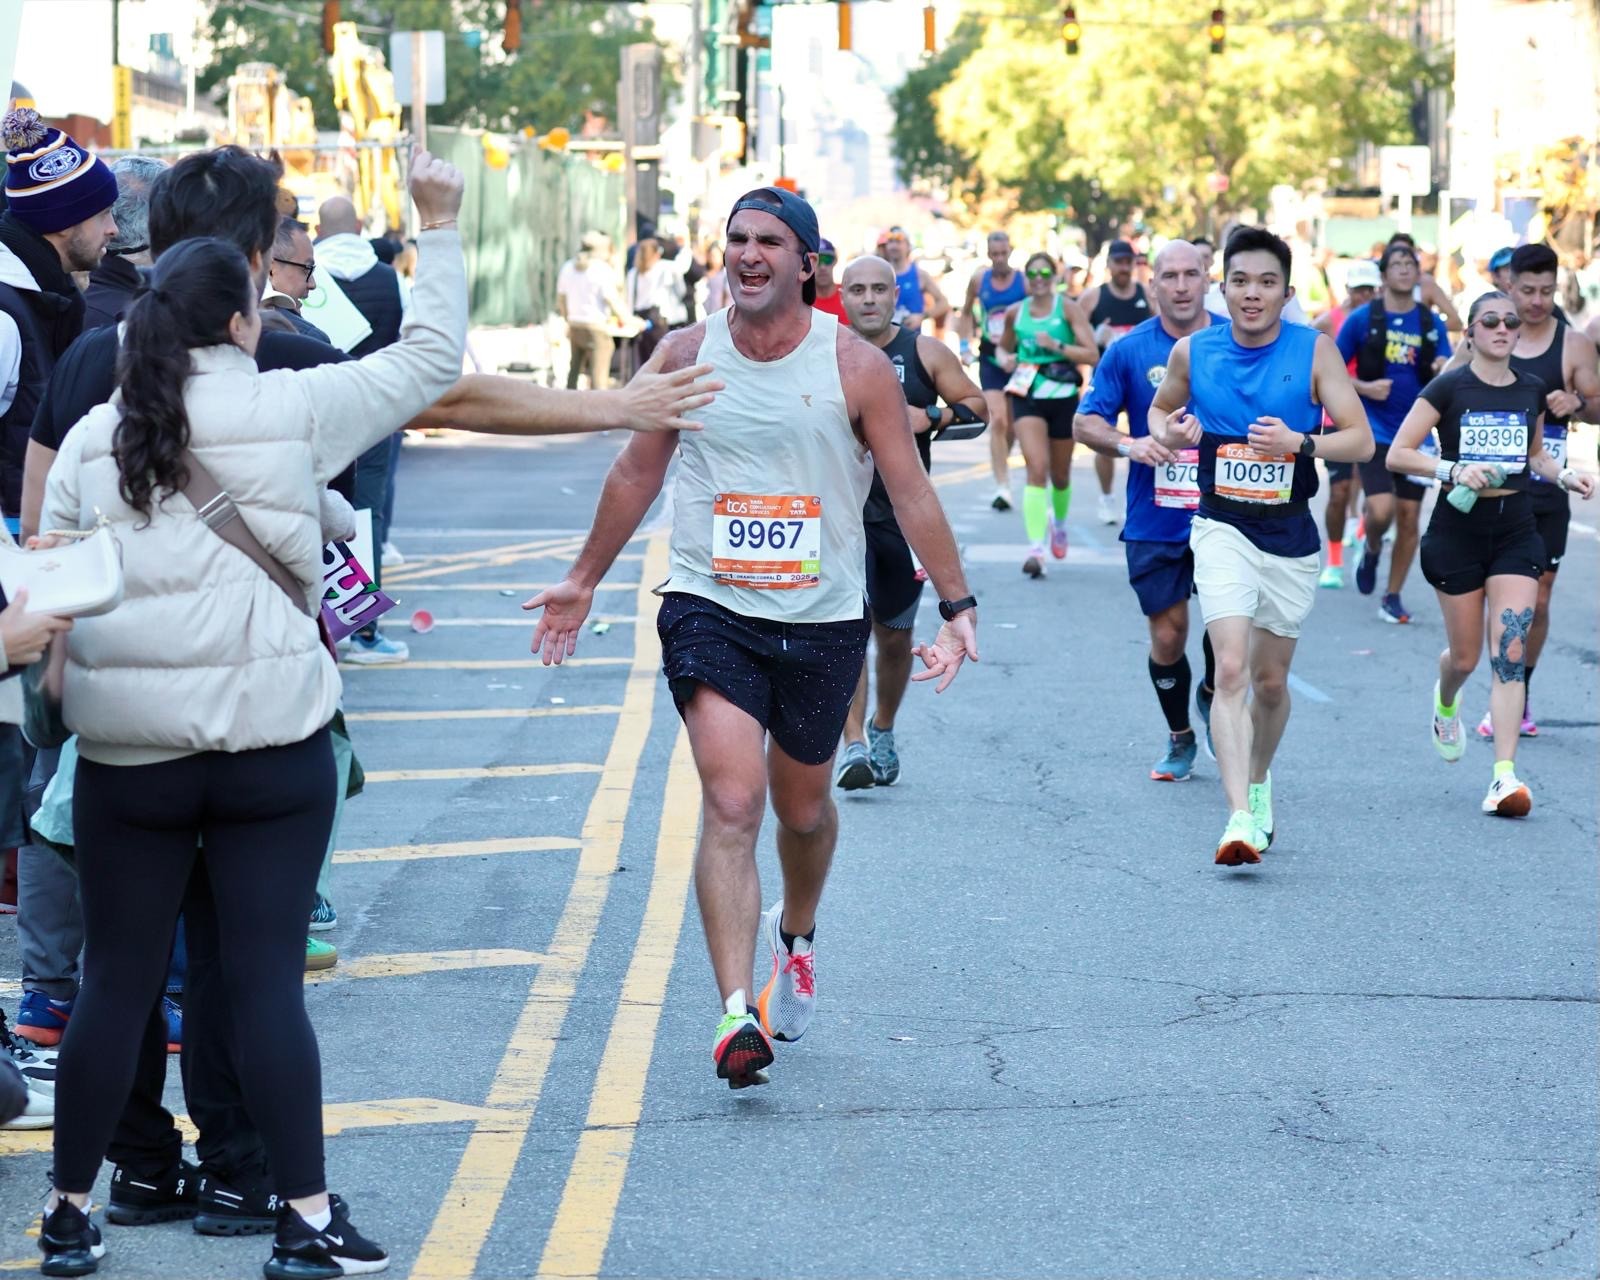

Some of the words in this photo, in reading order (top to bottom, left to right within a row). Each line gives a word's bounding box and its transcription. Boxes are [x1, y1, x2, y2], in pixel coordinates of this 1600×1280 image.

[1465, 428, 1525, 447] 39396
[1223, 461, 1286, 483] 10031
[727, 498, 748, 514] tcs
[728, 519, 804, 550] 9967
